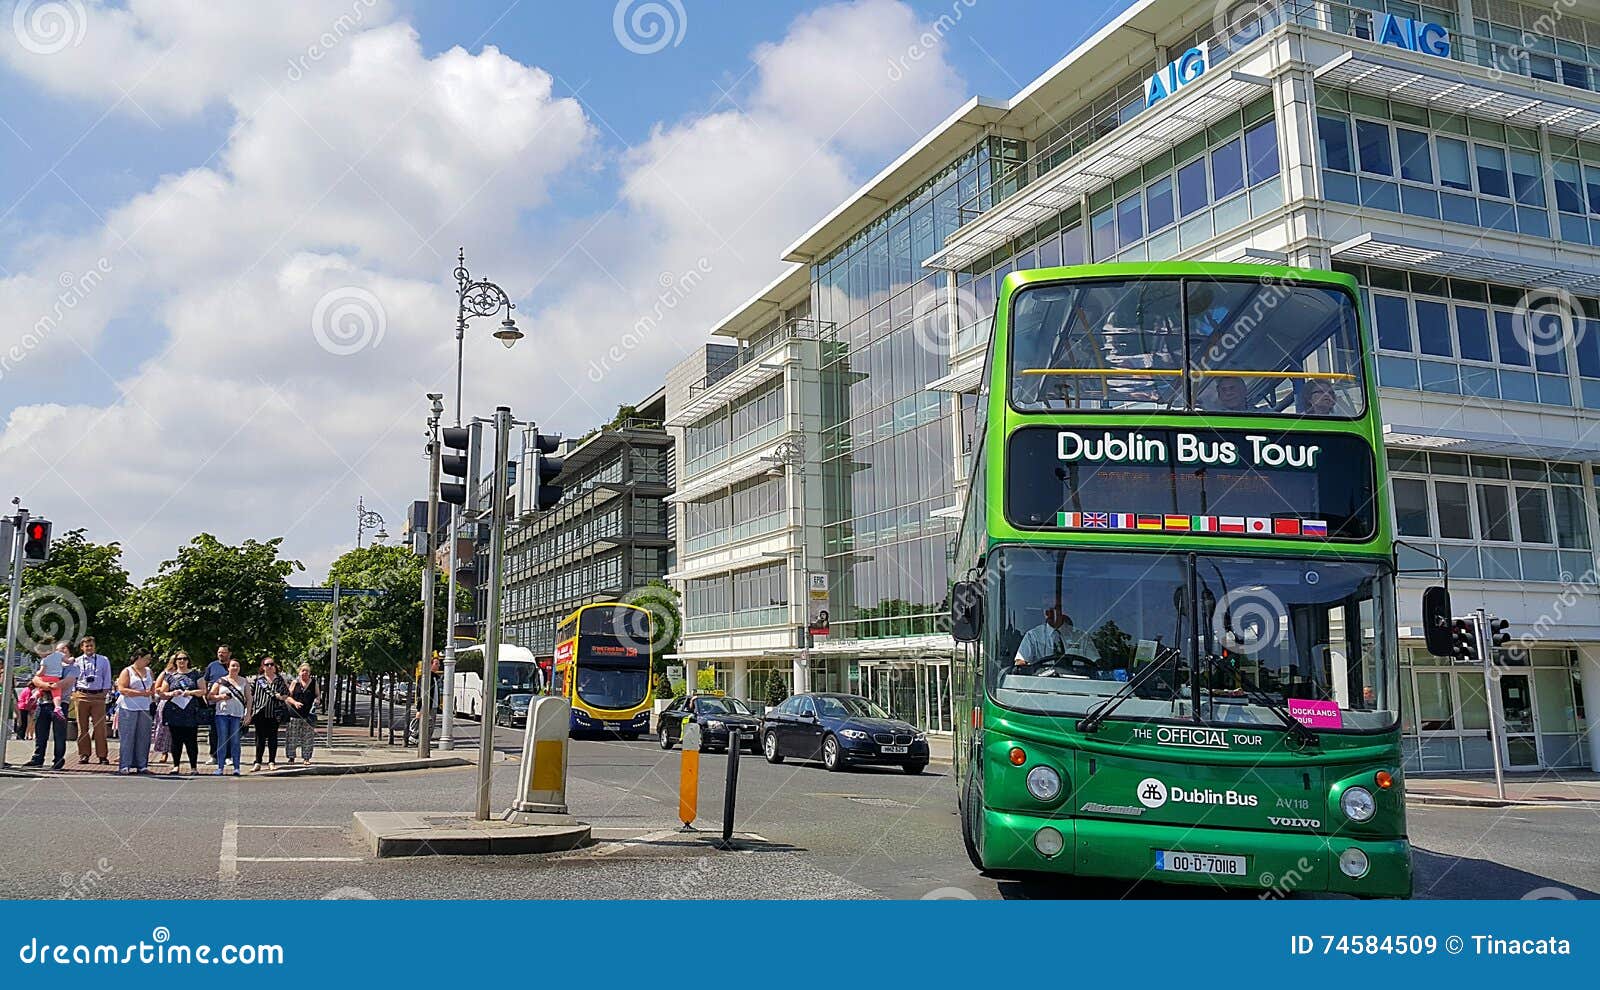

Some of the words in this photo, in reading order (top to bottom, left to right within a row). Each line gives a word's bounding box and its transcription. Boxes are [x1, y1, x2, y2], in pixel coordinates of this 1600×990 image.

[1379, 13, 1450, 58] AIG
[1146, 47, 1205, 108] AIG
[1057, 431, 1167, 462] Dublin
[1177, 433, 1237, 464] Bus
[1245, 435, 1320, 467] Tour
[1292, 707, 1337, 717] DOCKLANDS
[1133, 728, 1152, 739] THE
[1157, 727, 1229, 746] OFFICIAL
[1233, 734, 1262, 745] TOUR
[1171, 786, 1223, 804] Dublin
[1225, 791, 1258, 807] Bus
[1275, 798, 1309, 810] AV118
[1267, 816, 1321, 828] VOLVO
[1173, 856, 1237, 874] 00-D-70118
